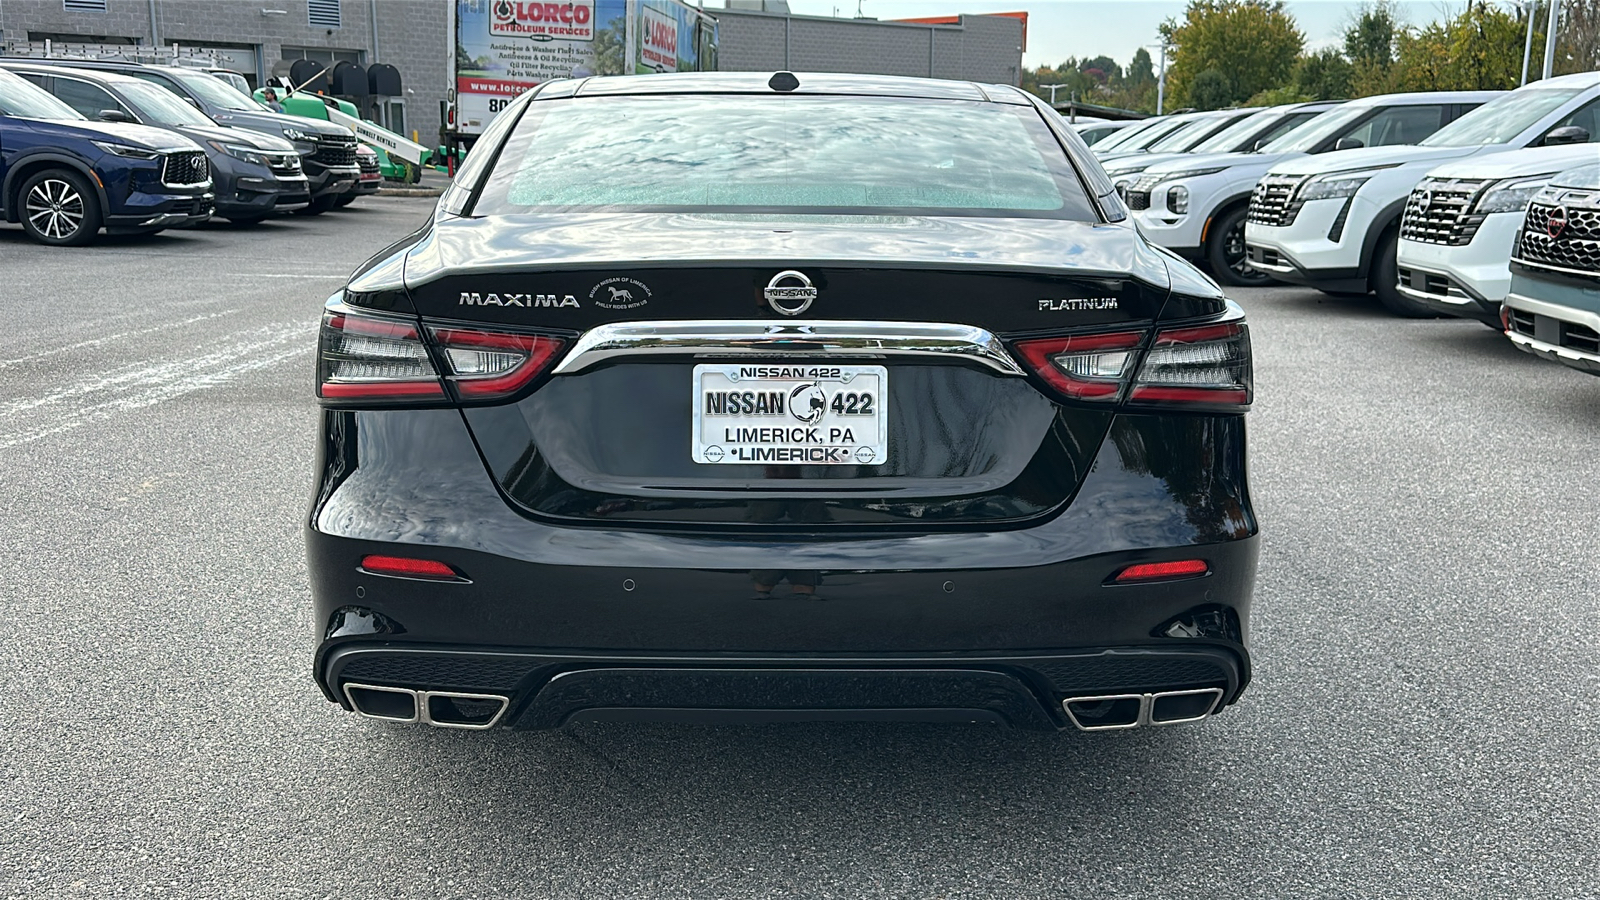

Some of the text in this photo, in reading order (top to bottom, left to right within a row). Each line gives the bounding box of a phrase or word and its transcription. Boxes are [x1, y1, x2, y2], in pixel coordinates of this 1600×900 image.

[516, 2, 590, 24] LORCO
[493, 23, 590, 36] PETROLEUM SERVICES
[651, 19, 676, 54] LORCO
[490, 43, 524, 52] Antifreeze
[531, 46, 556, 54] Washer
[557, 46, 575, 55] Fluid
[498, 52, 532, 61] Antifreeze
[540, 54, 551, 62] Oil
[551, 55, 585, 64] Recycling
[506, 69, 576, 79] Parts Washer Service
[540, 63, 573, 72] Recycling
[470, 82, 532, 93] www.lorco
[489, 98, 512, 113] 80
[589, 283, 601, 298] BUSH
[600, 277, 620, 286] NISSAN
[629, 278, 653, 297] LIMERICK
[769, 289, 811, 297] NISSAN
[459, 292, 580, 308] MAXIMA
[595, 301, 612, 309] PHILLY
[1038, 298, 1118, 311] PLATINUM
[740, 367, 841, 378] NISSAN 422
[706, 391, 873, 414] NISSAN 422
[725, 428, 855, 444] LIMERICK, PA
[738, 447, 840, 461] LIMERICK
